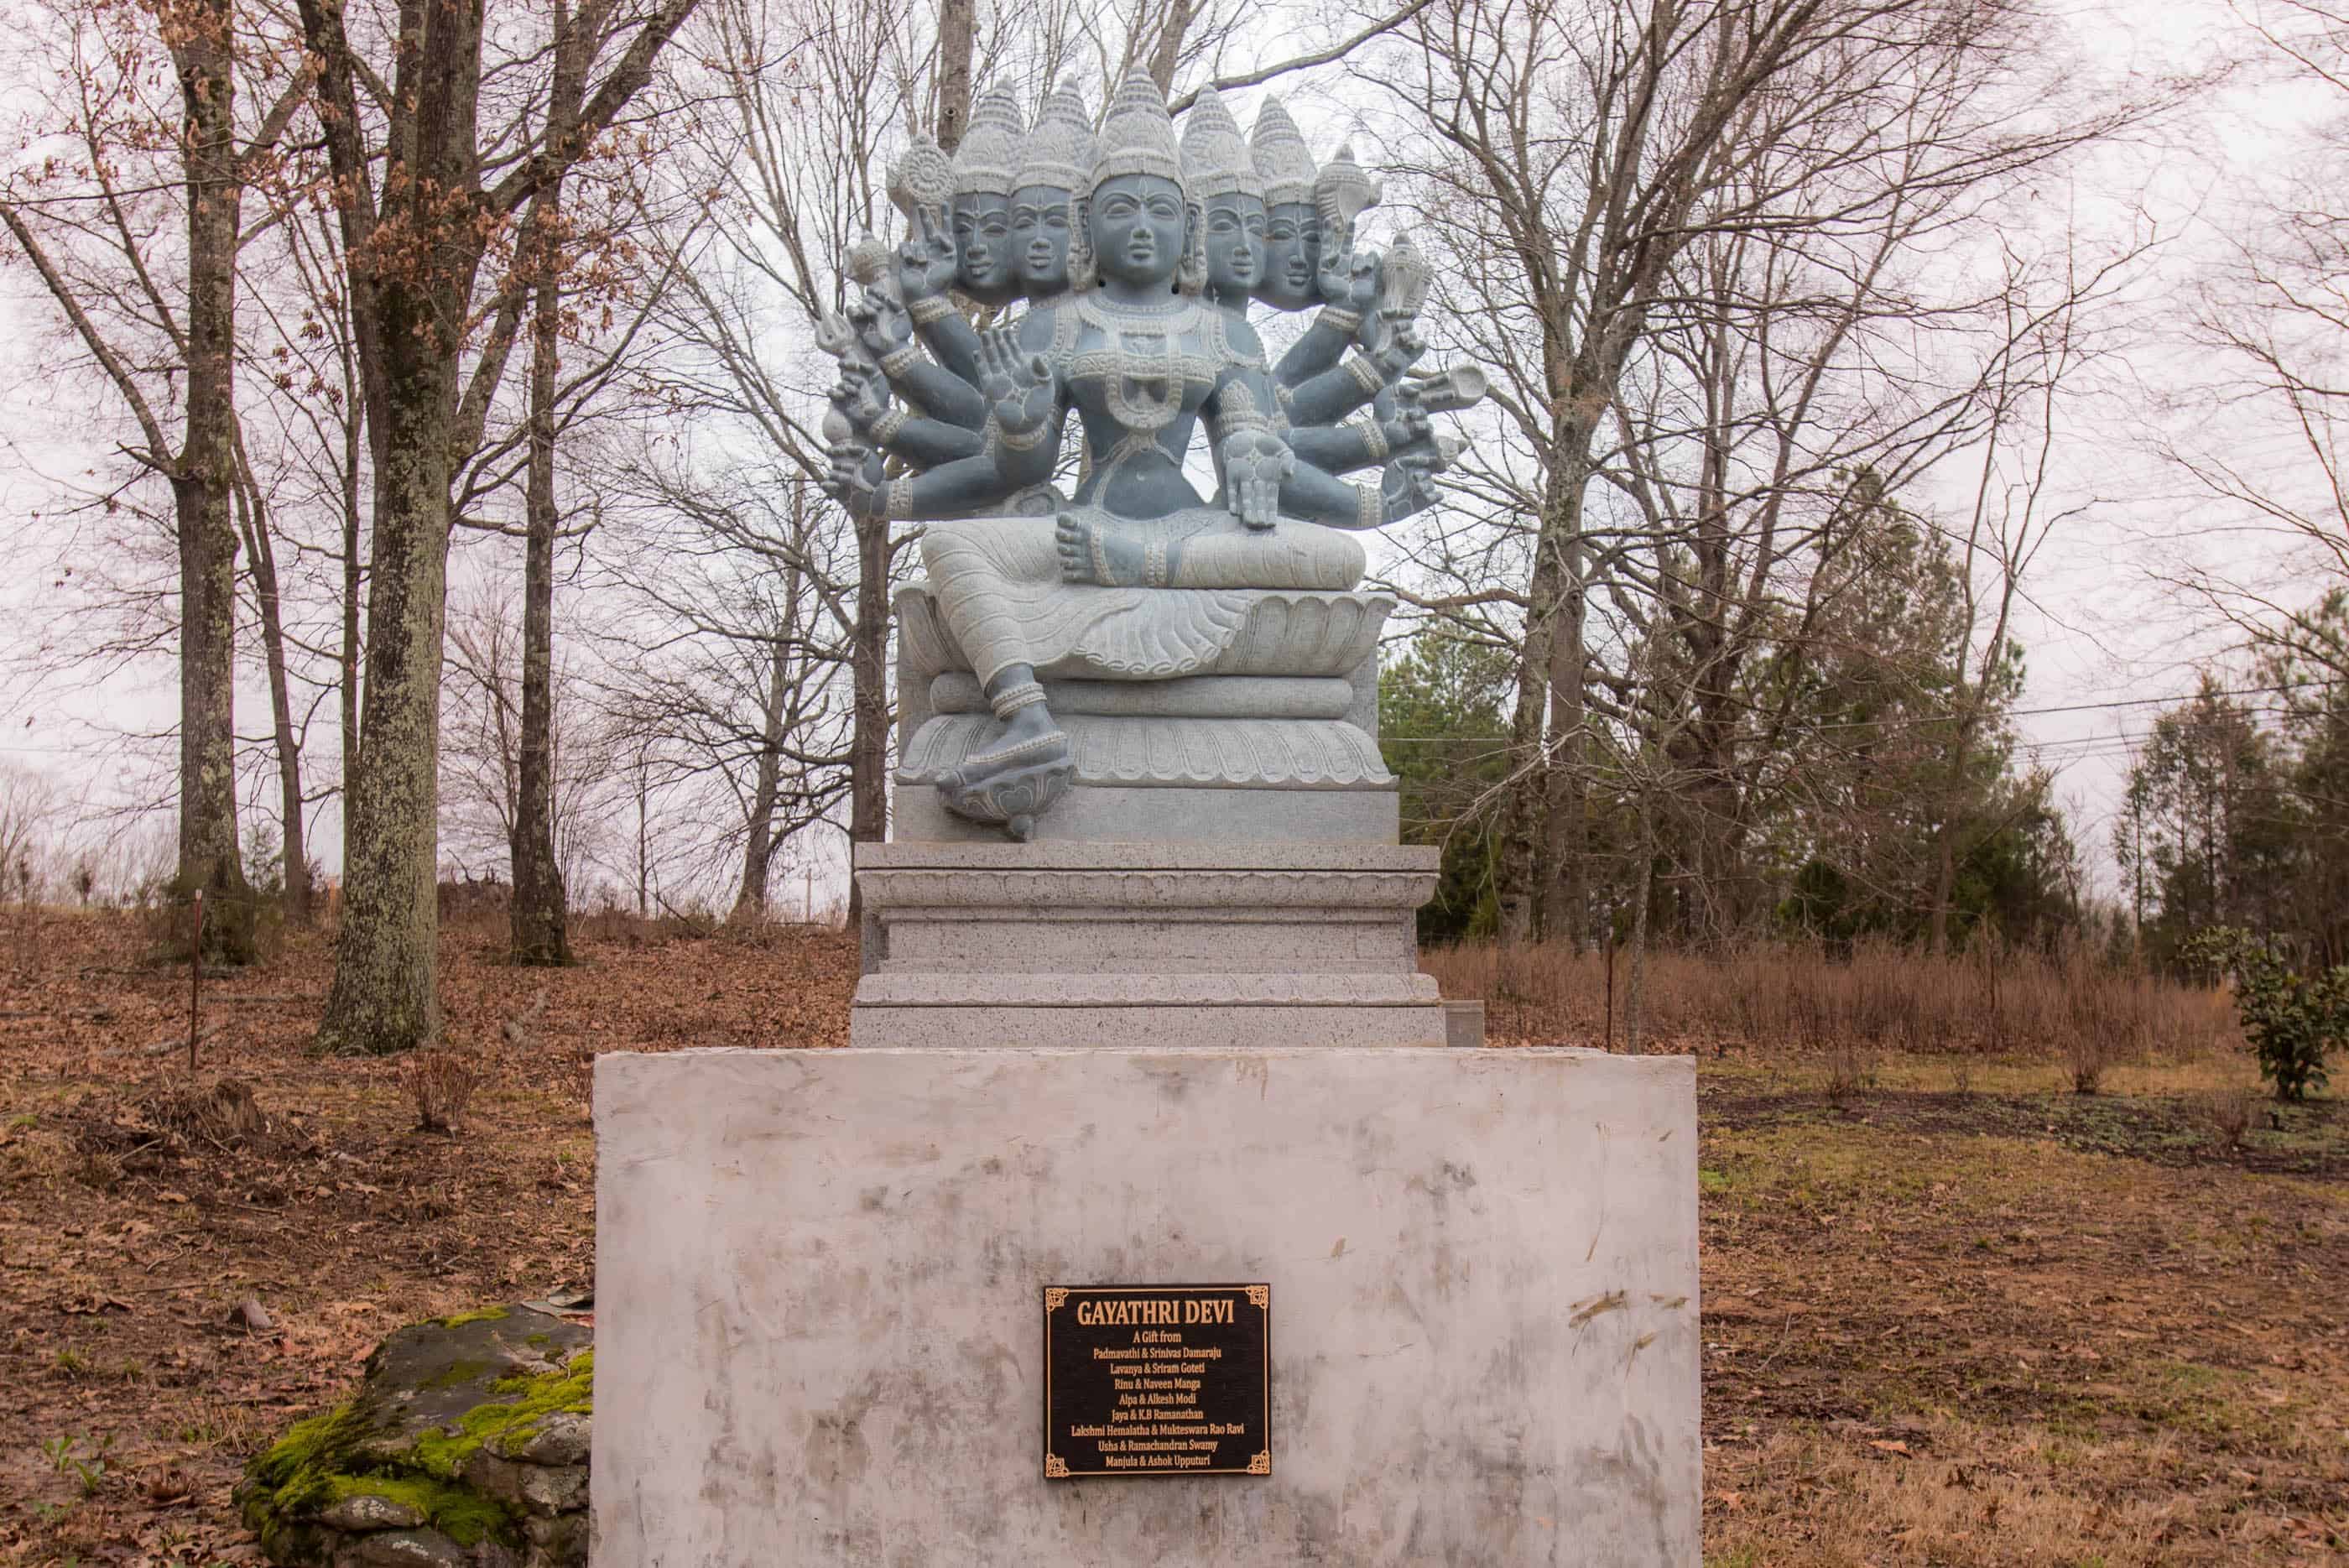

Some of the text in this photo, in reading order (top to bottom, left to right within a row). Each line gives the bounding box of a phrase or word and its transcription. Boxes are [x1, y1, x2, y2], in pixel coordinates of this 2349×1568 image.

[1077, 1300, 1234, 1325] GAYATHRI DEVI
[1133, 1331, 1181, 1342] A Gift from
[1094, 1347, 1221, 1360] Padmavathi & Srinivas Damaraju
[1111, 1362, 1205, 1376] Lavanya & Sriram Goteti
[1115, 1378, 1201, 1391] Rinu & Naveen Manga
[1119, 1393, 1195, 1407] Alpa & Alkesh Modi
[1112, 1409, 1128, 1423] Jaya
[1130, 1409, 1137, 1420] &
[1154, 1409, 1203, 1420] Ramanathan
[1071, 1423, 1244, 1436] Lakshmi Hemalatha & Mukteswara Rao Ravi
[1098, 1440, 1217, 1452] Usha & Ramachandran Swamy
[1107, 1455, 1210, 1468] Manjula & Ashok Upputuri
